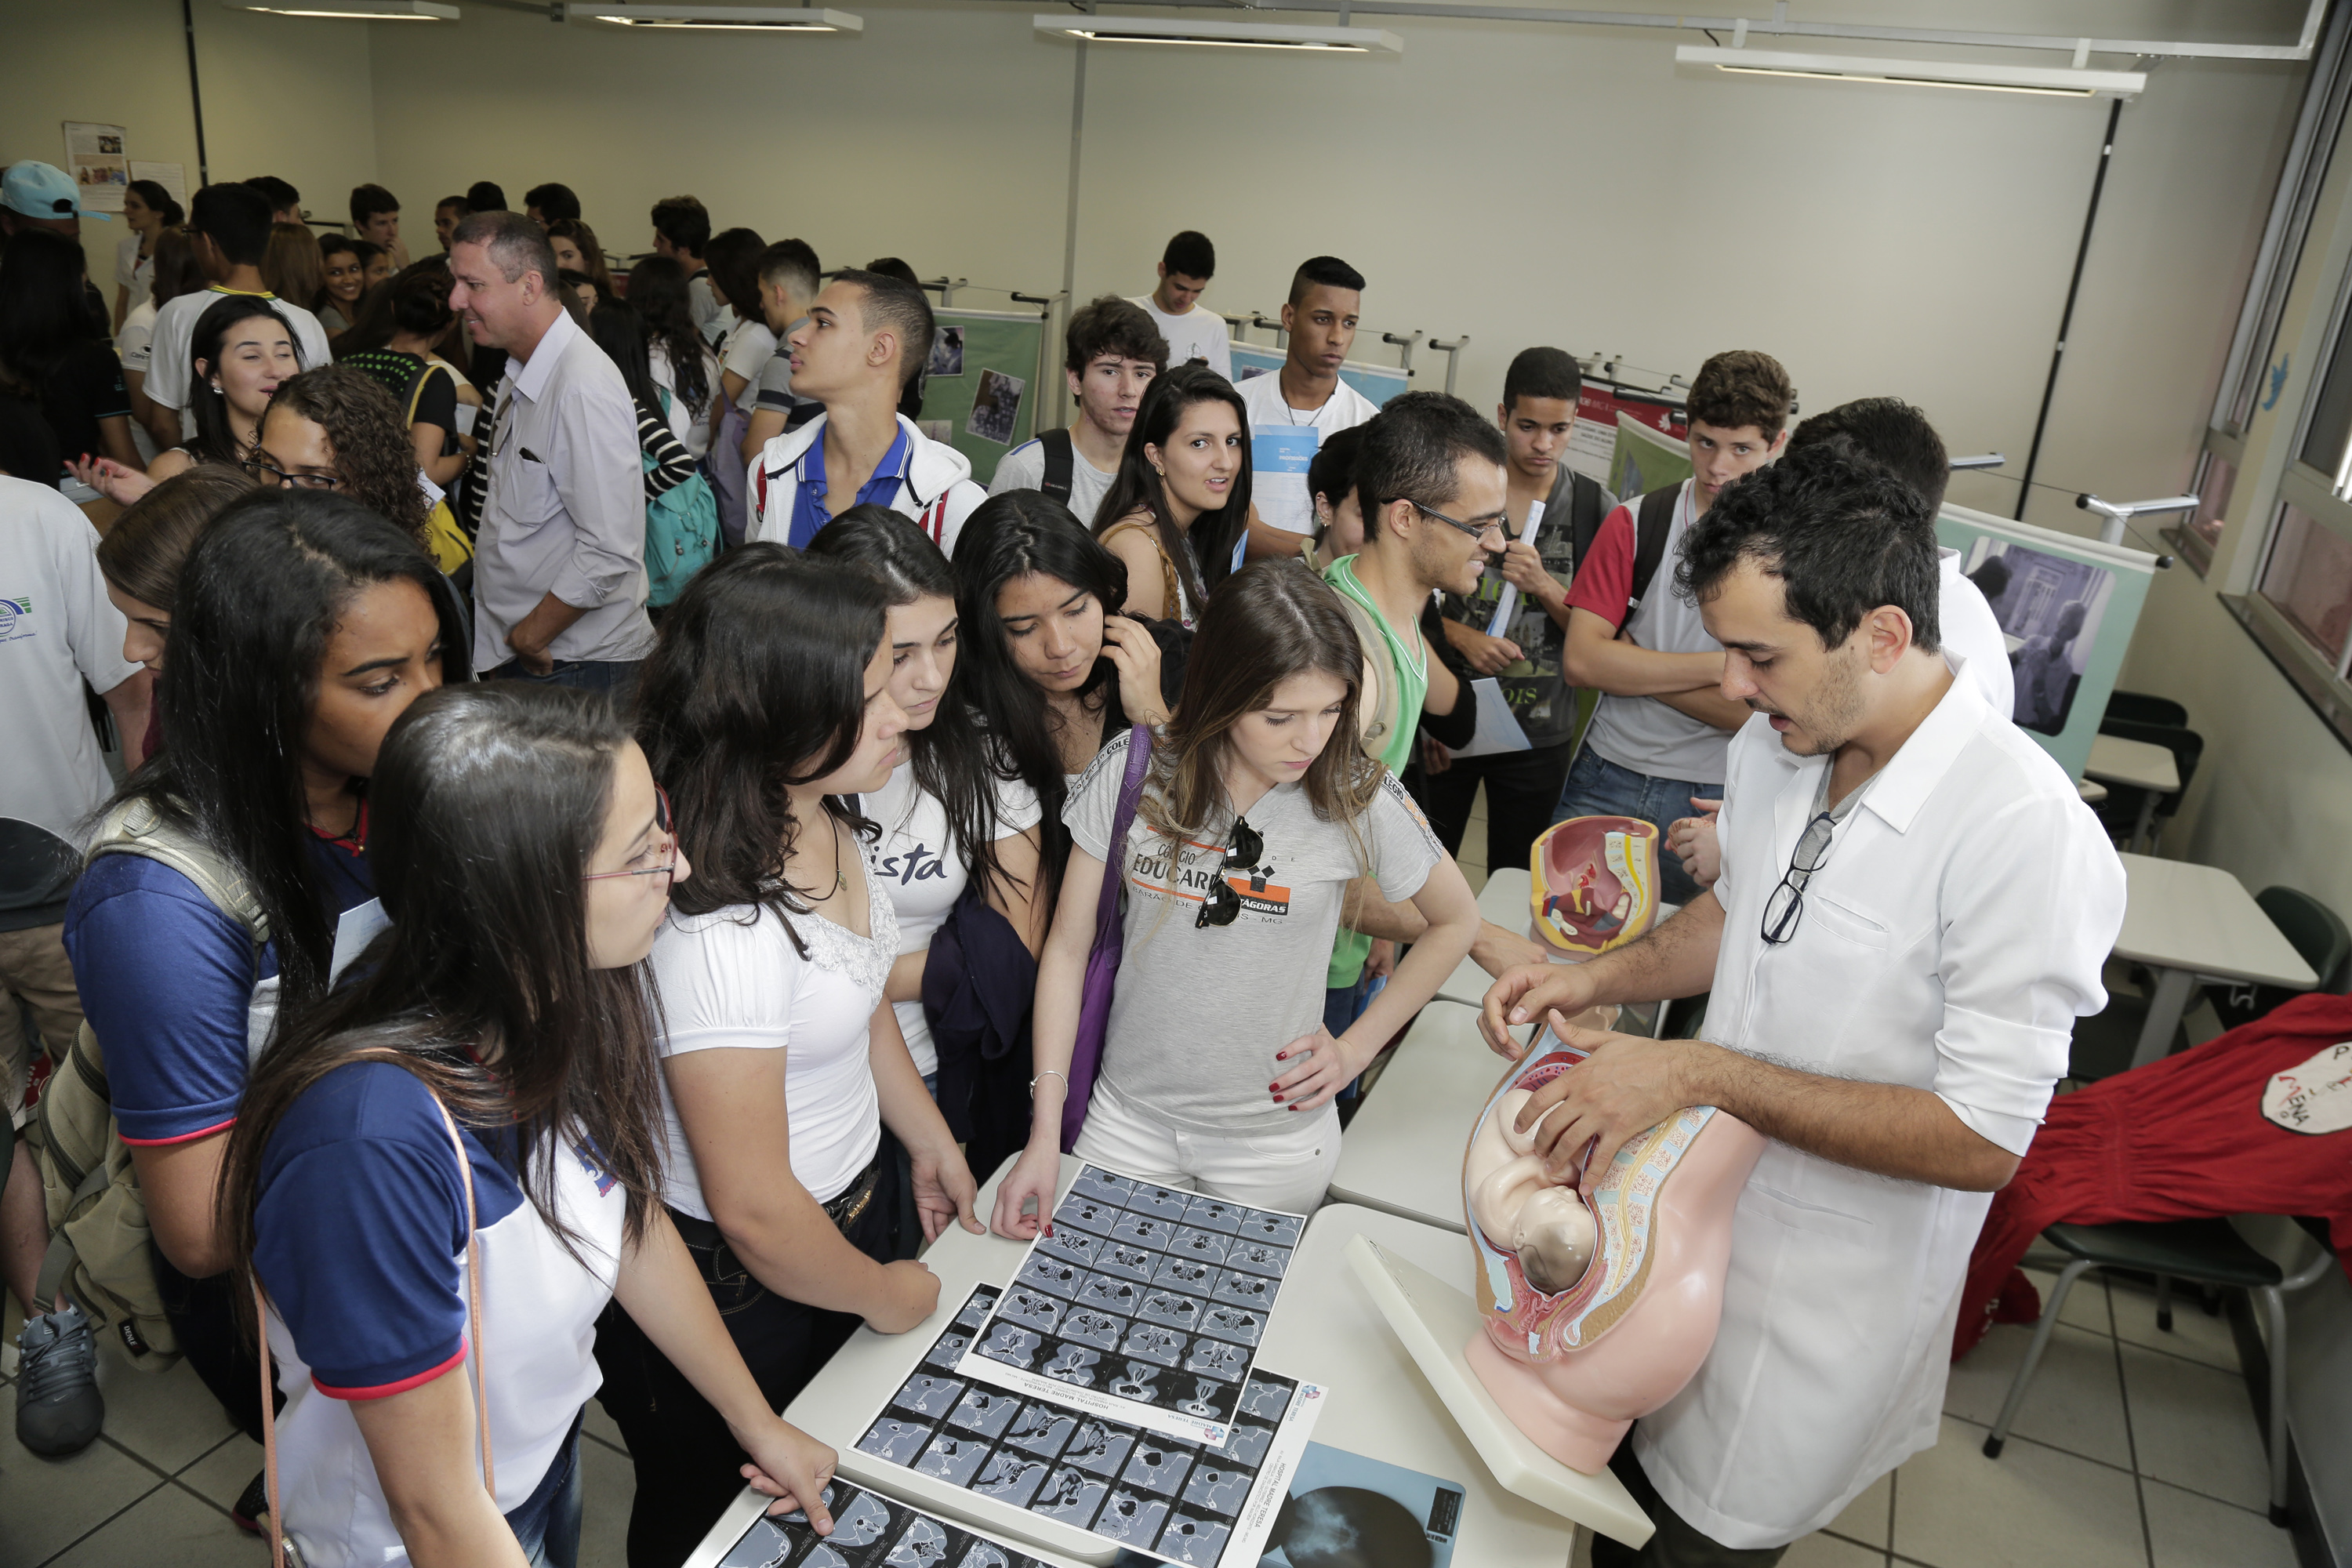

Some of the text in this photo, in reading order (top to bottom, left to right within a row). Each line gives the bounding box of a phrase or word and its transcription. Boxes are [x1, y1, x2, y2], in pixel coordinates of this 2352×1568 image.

[1501, 687, 1537, 704] OIS
[1106, 737, 1129, 755] COLÉ
[1384, 776, 1403, 800] LÉGIO
[1158, 844, 1196, 866] COLGIO
[870, 843, 948, 885] ista
[1133, 853, 1217, 891] EDUCAR
[1176, 899, 1193, 909] DE
[1240, 897, 1287, 913] TÁGORAS
[1261, 916, 1283, 924] MG
[1024, 1382, 1109, 1410] HOSPITAL MADRE TERESA
[1295, 1392, 1305, 1406] MADRE
[1167, 1414, 1189, 1423] TERESA
[1289, 1407, 1298, 1421] TERESA
[1191, 1419, 1212, 1428] MADRE
[1254, 1463, 1286, 1527] HOSPITAL MADRE TERESA
